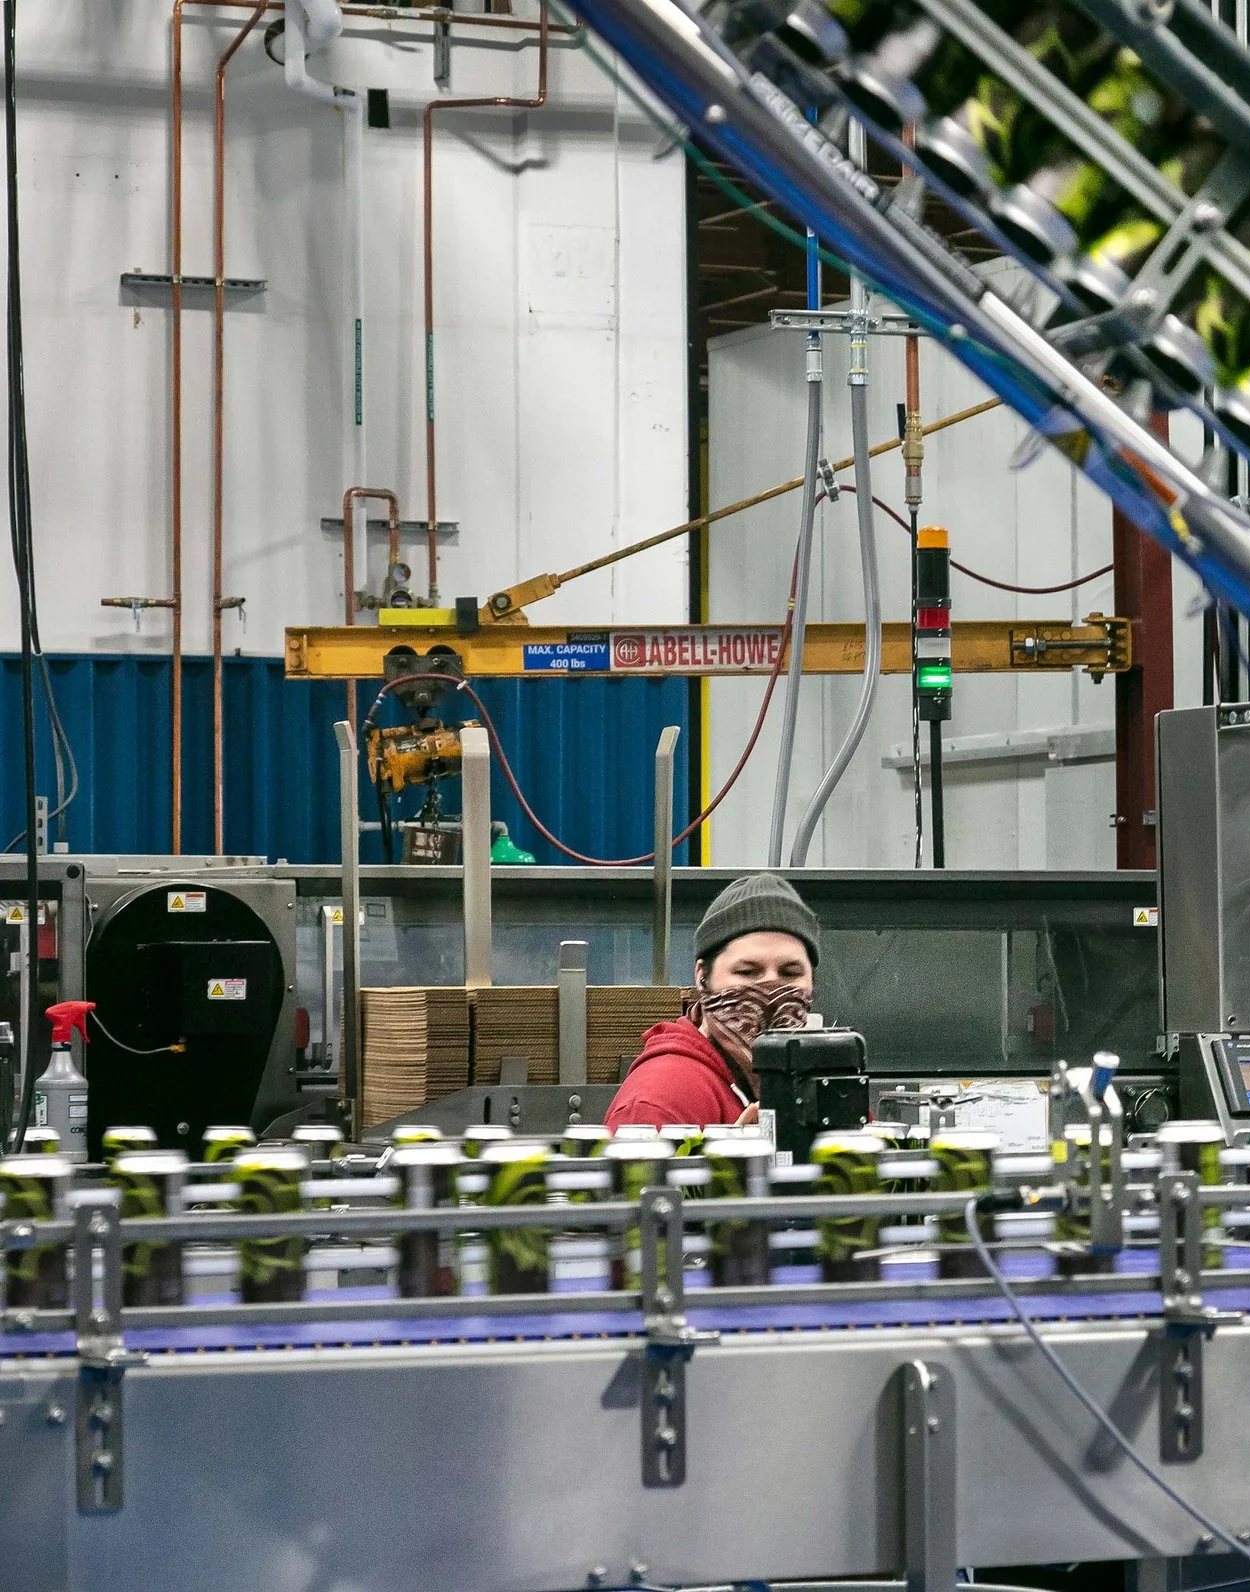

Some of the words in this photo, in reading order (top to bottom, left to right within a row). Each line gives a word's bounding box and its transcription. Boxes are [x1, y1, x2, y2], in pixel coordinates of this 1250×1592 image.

[528, 645, 554, 655] MAX.
[556, 644, 606, 654] CAPACITY
[650, 633, 779, 666] ABELL-HOWE
[549, 658, 569, 668] 400
[570, 658, 586, 668] lbs
